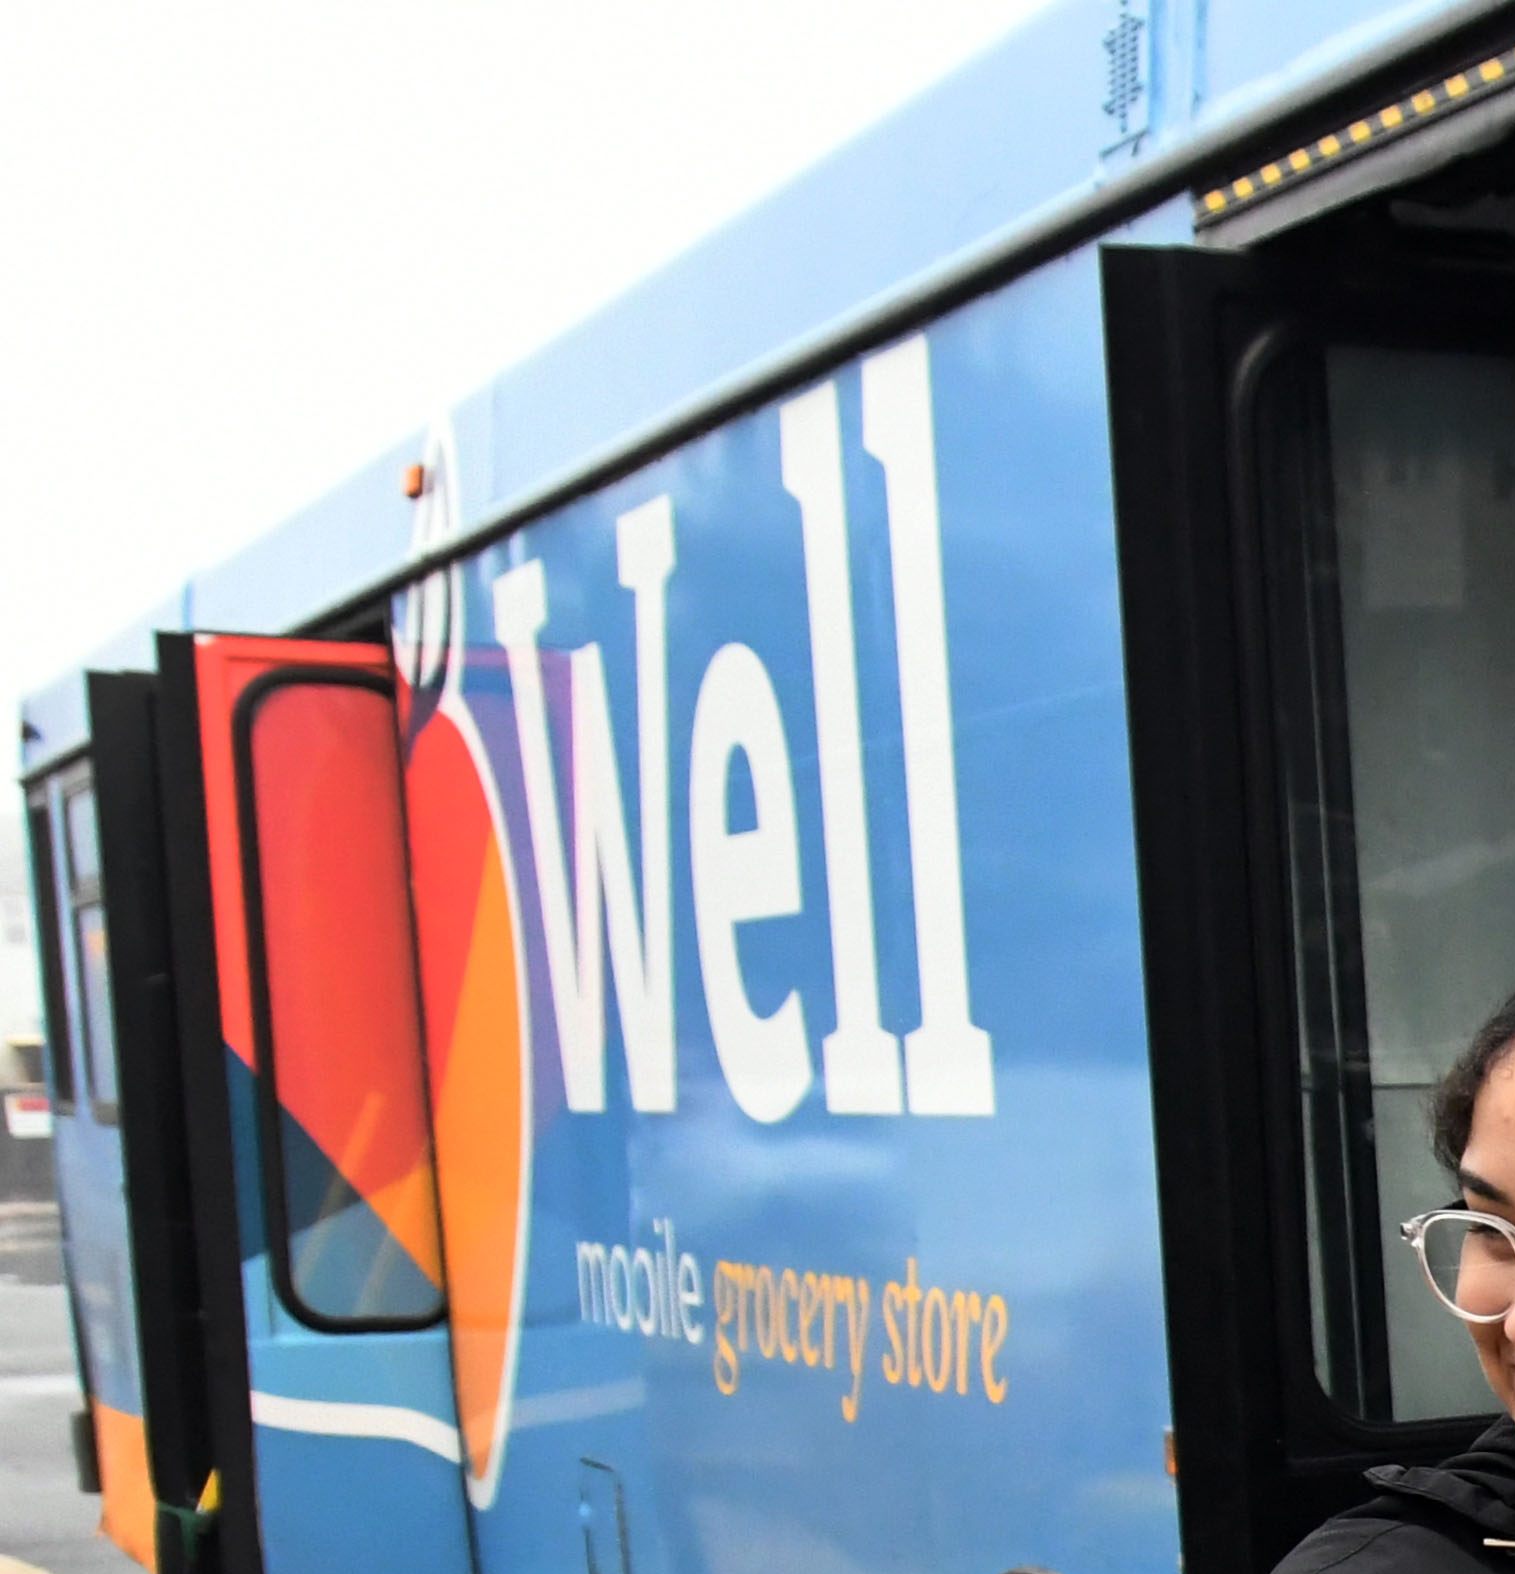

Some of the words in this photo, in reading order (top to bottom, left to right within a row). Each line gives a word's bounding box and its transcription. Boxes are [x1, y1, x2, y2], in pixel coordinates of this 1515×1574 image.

[494, 333, 995, 1122] Well
[713, 1259, 870, 1423] grocery
[883, 1257, 1008, 1404] store
